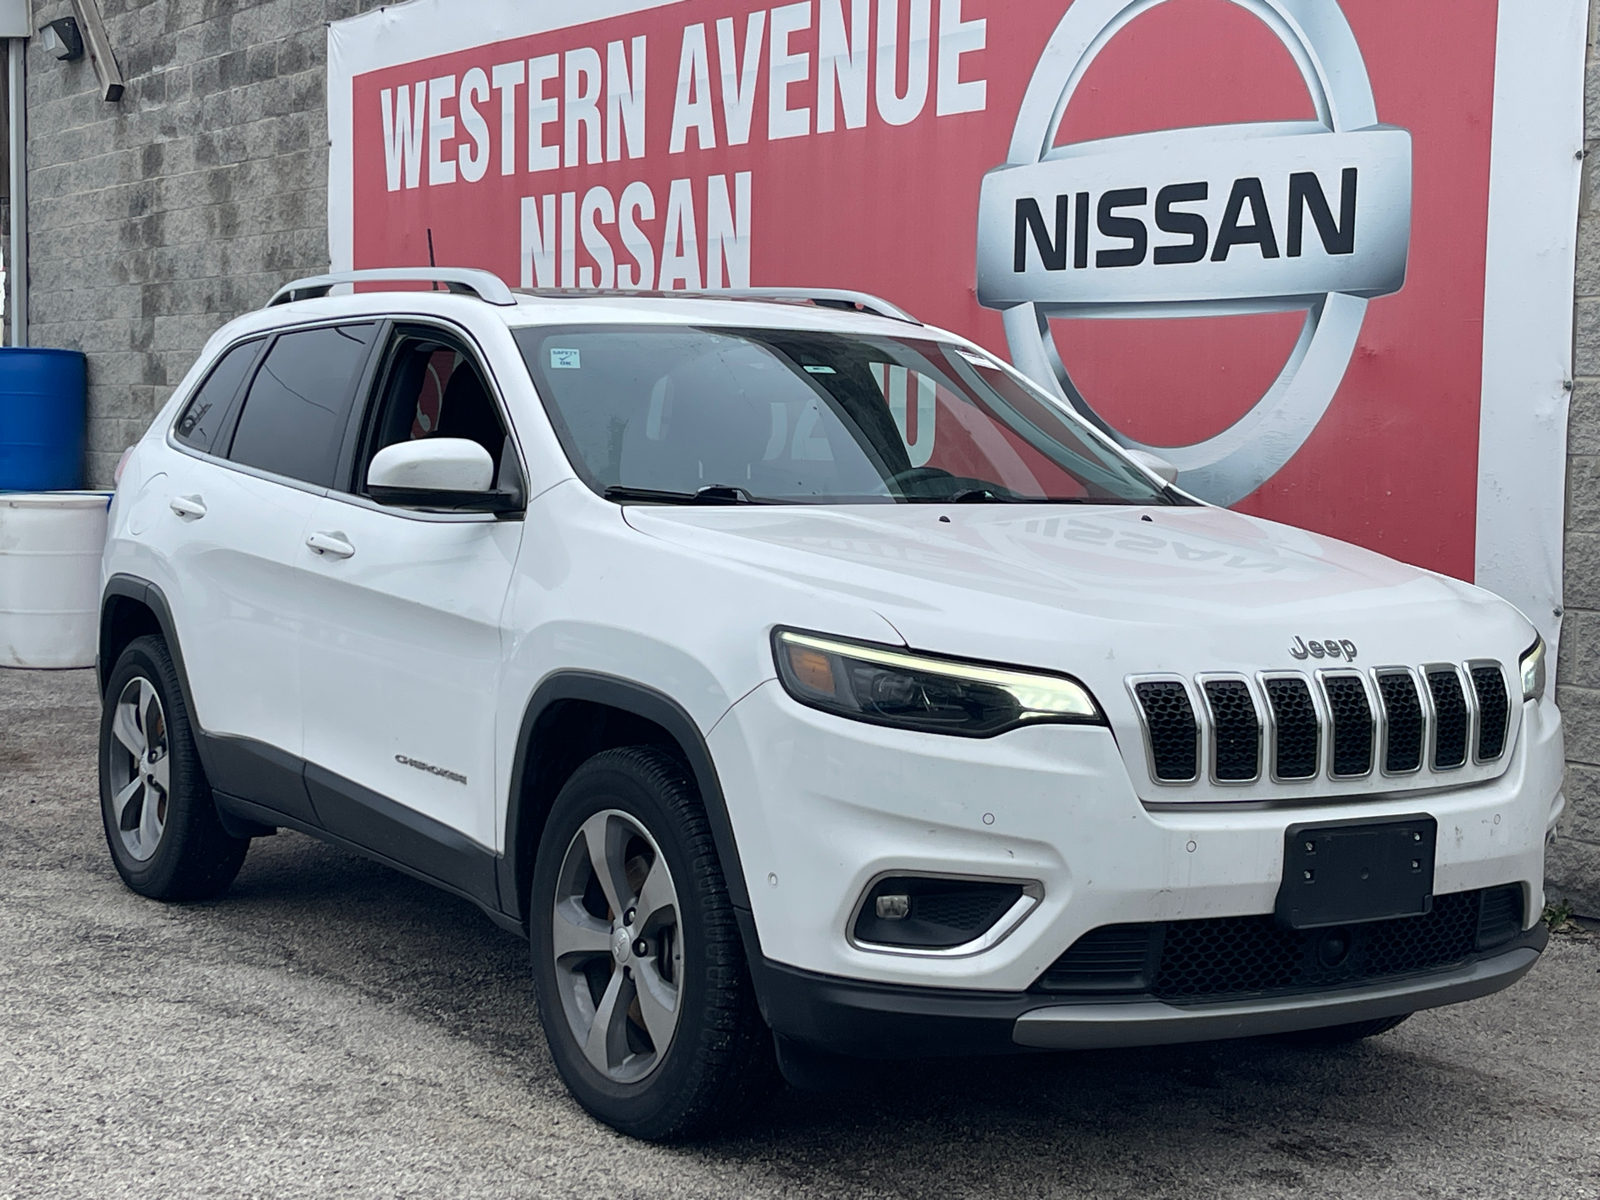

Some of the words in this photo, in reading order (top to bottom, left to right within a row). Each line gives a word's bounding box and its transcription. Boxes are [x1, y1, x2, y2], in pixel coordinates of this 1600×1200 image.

[380, 35, 648, 192] WESTERN
[669, 0, 987, 154] AVENUE
[520, 171, 752, 290] NISSAN
[1013, 167, 1358, 273] NISSAN
[1287, 635, 1357, 663] Jeep
[394, 754, 468, 786] CHEROKEE
